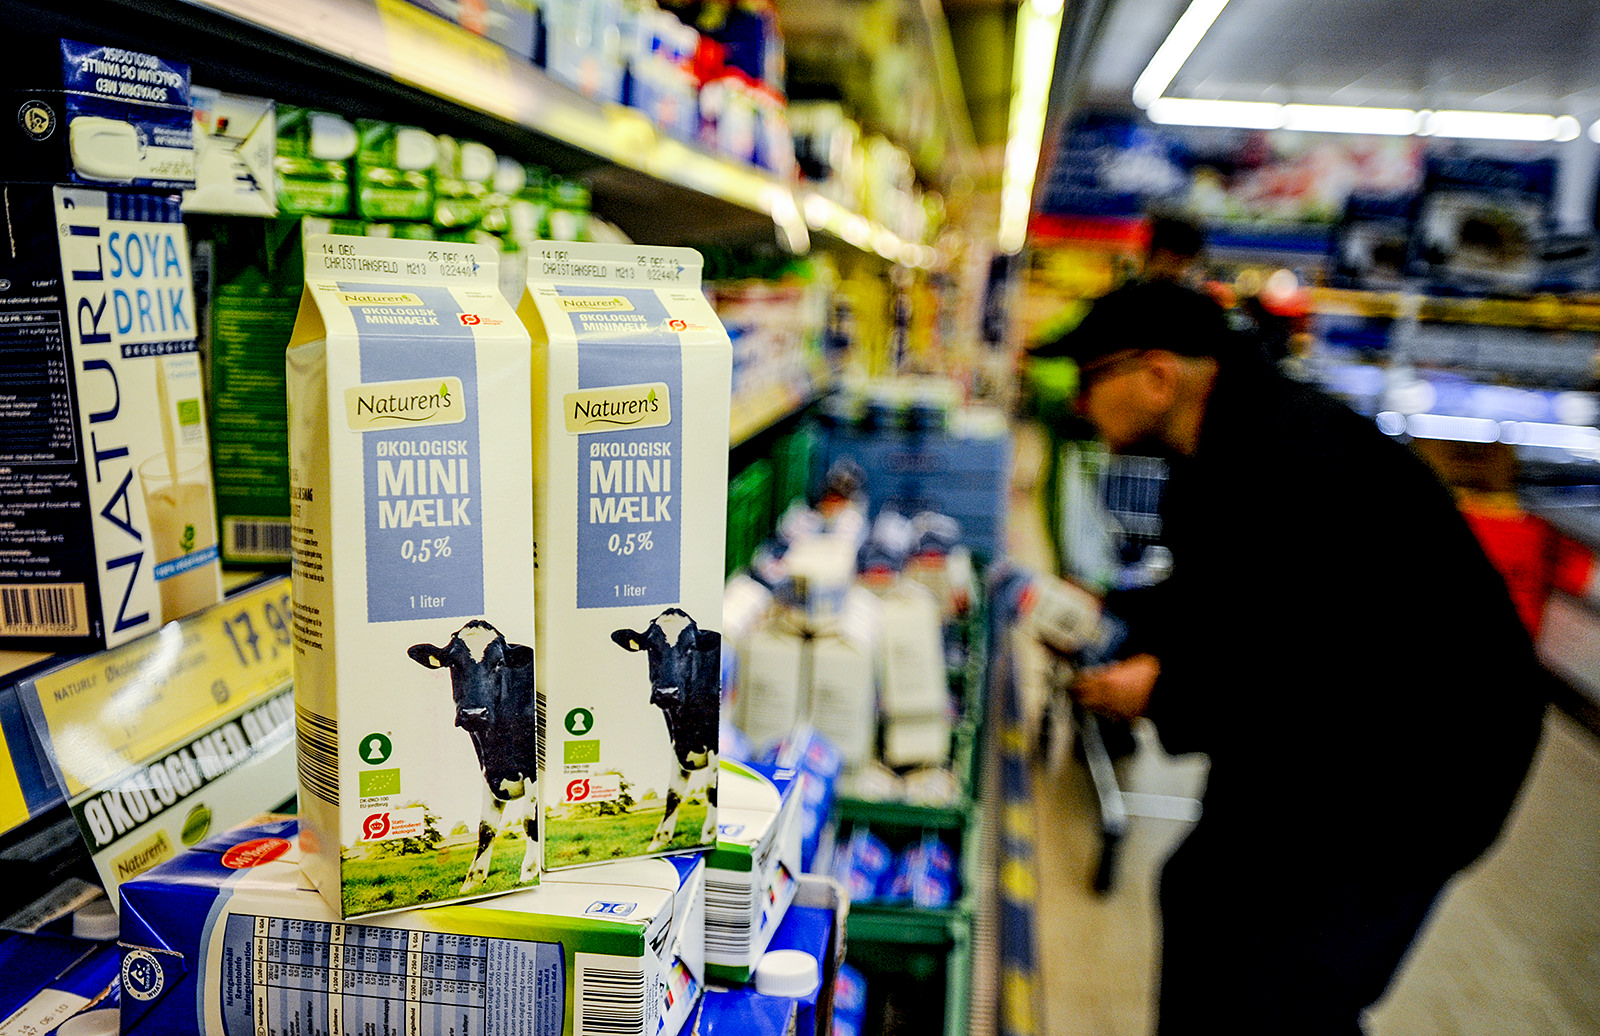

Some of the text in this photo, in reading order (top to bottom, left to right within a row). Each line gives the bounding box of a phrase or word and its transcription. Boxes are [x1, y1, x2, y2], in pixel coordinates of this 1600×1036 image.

[81, 57, 121, 78] VANILLE
[121, 64, 137, 80] OG
[95, 77, 118, 94] MED
[108, 231, 183, 279] SOYA
[322, 244, 334, 255] 14
[339, 245, 356, 256] DEC
[428, 251, 439, 262] 25
[443, 252, 459, 264] DEC
[541, 250, 551, 260] 14
[555, 250, 569, 262] DEC
[637, 256, 646, 267] 25
[650, 257, 665, 268] DEC
[324, 256, 399, 274] CHRISTIANSFELD
[406, 263, 427, 276] M213
[542, 262, 607, 279] CHRISTIANSFELD
[615, 267, 635, 280] M213
[345, 292, 412, 305] Naturen's
[563, 297, 624, 309] Naturen's
[113, 287, 189, 335] DRIK
[362, 306, 436, 317] ØKOLOGISK
[365, 315, 440, 326] MINIMÆLK
[579, 313, 647, 323] ØKOLOGISK
[583, 321, 650, 332] MINIMÆLK
[357, 387, 452, 415] Naturen's
[574, 391, 659, 419] Naturen's
[376, 440, 468, 457] ØKOLOGISK
[590, 442, 672, 458] ØKOLOGISK
[377, 458, 469, 497] MINI
[589, 459, 671, 494] MINI
[378, 498, 471, 529] MÆLK
[589, 495, 672, 524] MÆLK
[401, 536, 452, 564] 0,5%
[608, 531, 654, 556] 0,5%
[614, 584, 647, 597] 1 liter
[409, 595, 446, 609] 1 liter
[84, 748, 200, 846] ØKOLOGI
[192, 721, 250, 780] MED
[244, 942, 252, 1016] Næringsinformation
